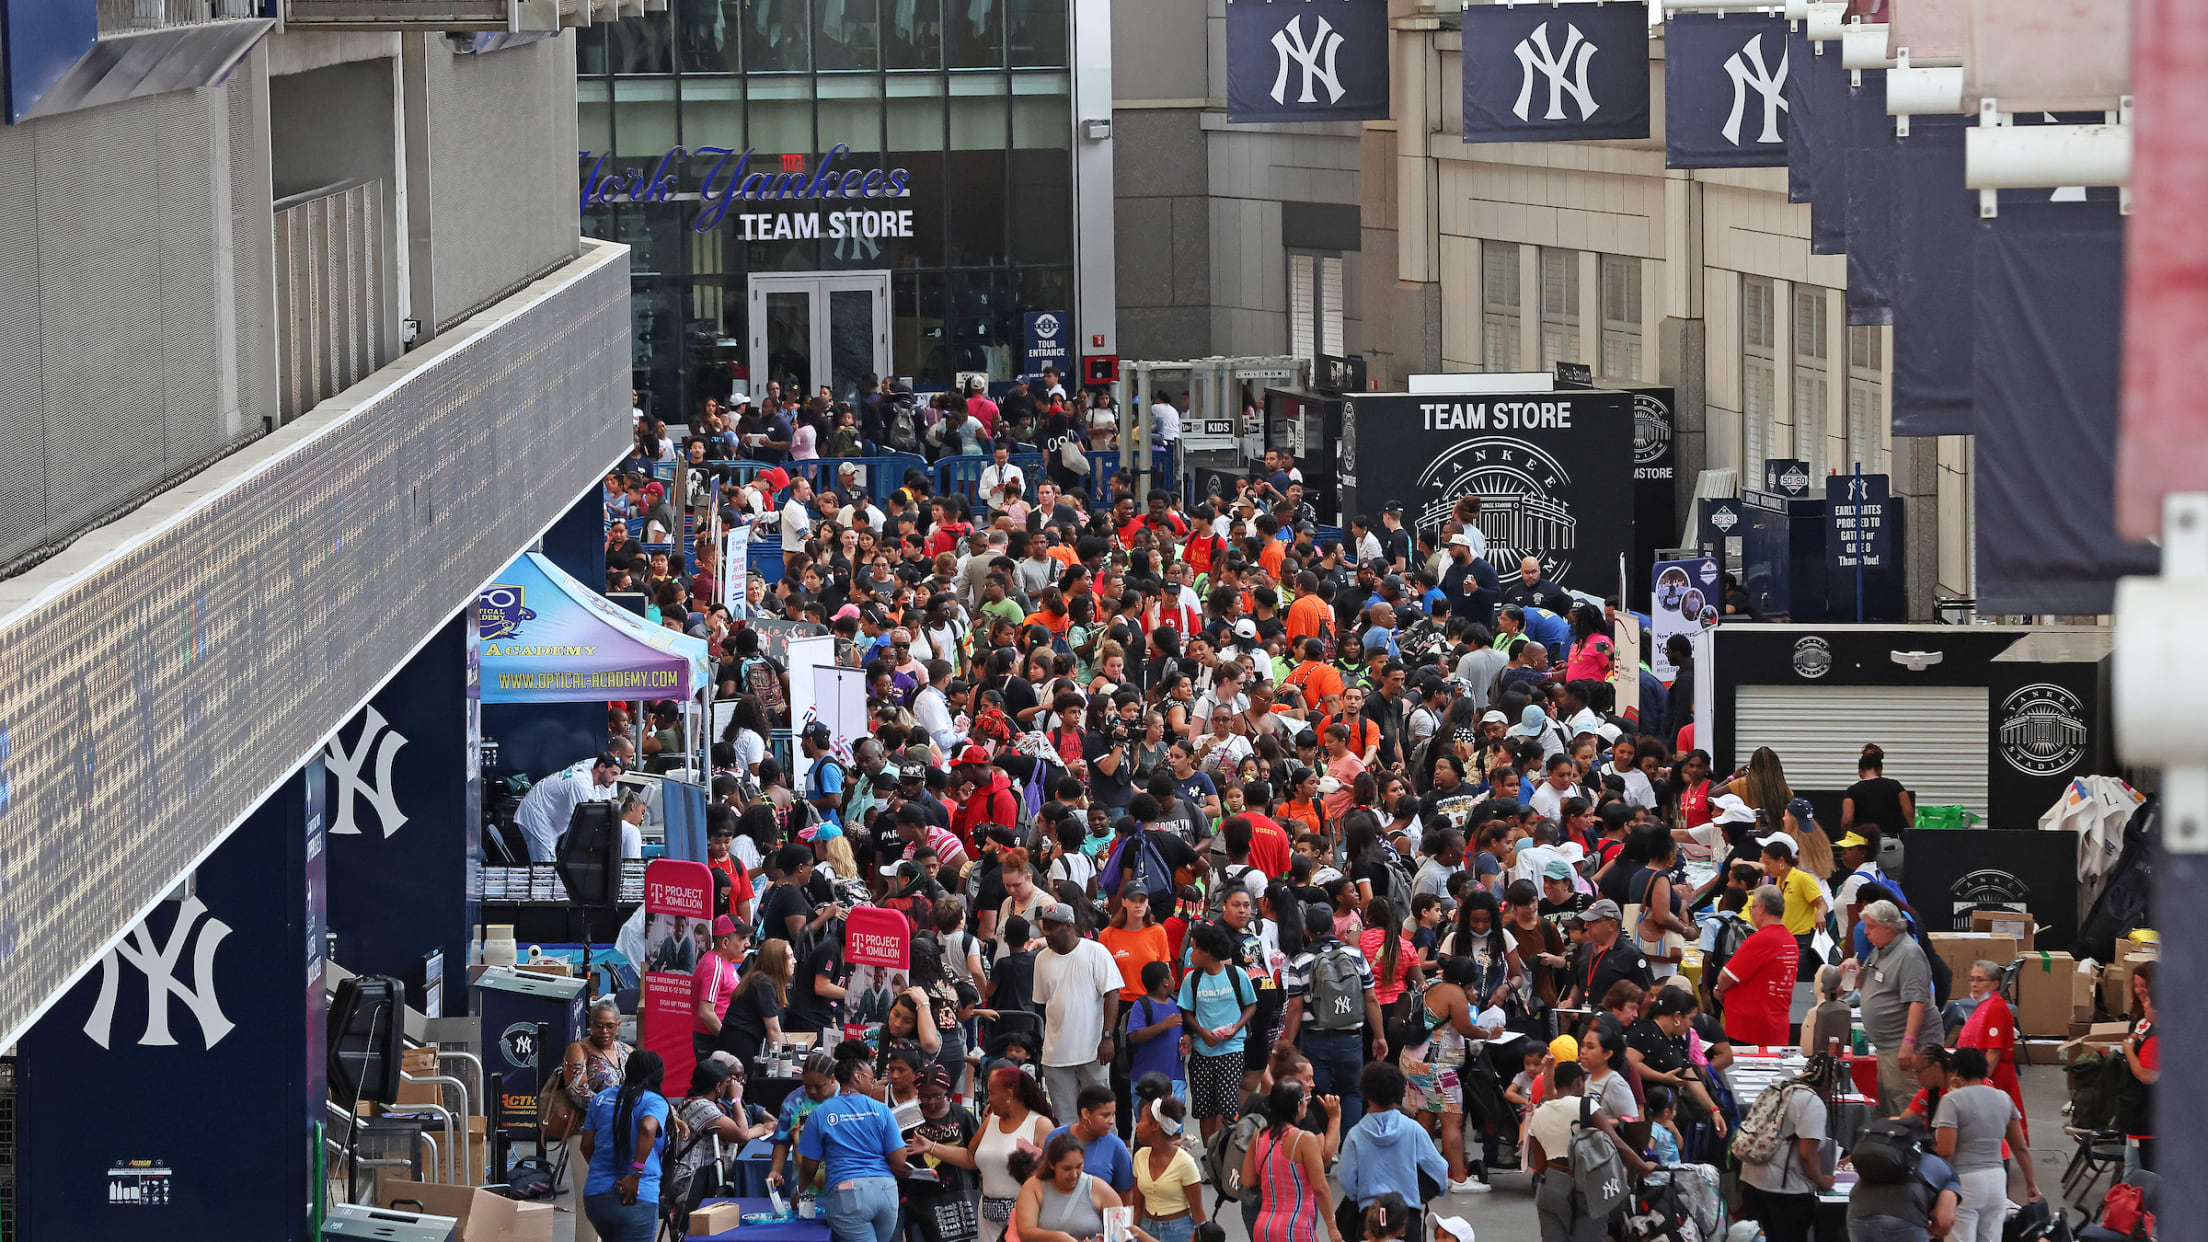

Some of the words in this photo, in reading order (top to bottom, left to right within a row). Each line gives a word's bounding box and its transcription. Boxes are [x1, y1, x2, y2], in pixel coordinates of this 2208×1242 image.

[692, 143, 911, 233] Yankees
[739, 212, 820, 241] TEAM
[828, 209, 914, 239] STORE
[1038, 340, 1056, 348] TOUR
[1028, 348, 1065, 357] ENTRANCE
[1420, 403, 1485, 430] TEAM
[1493, 402, 1572, 429] STORE
[1208, 422, 1230, 433] KIDS
[1432, 449, 1556, 489] YANKEE
[1836, 517, 1869, 529] PROCED
[1869, 517, 1880, 527] TO
[1866, 532, 1875, 540] or
[1846, 543, 1864, 553] GAE
[1838, 555, 1858, 566] Than
[1863, 555, 1880, 566] You!
[498, 670, 678, 690] WWW.OPTICAL-ACADEMY.COM
[2008, 690, 2077, 713] YANKEE
[2008, 746, 2077, 770] STADIUM
[665, 885, 703, 899] PROJECT
[665, 897, 703, 910] 10MILLION
[865, 934, 900, 947] PROJECT
[865, 946, 900, 959] 10MILLION
[1334, 995, 1352, 1015] NY
[516, 1035, 532, 1053] NY
[1601, 1177, 1621, 1200] NY
